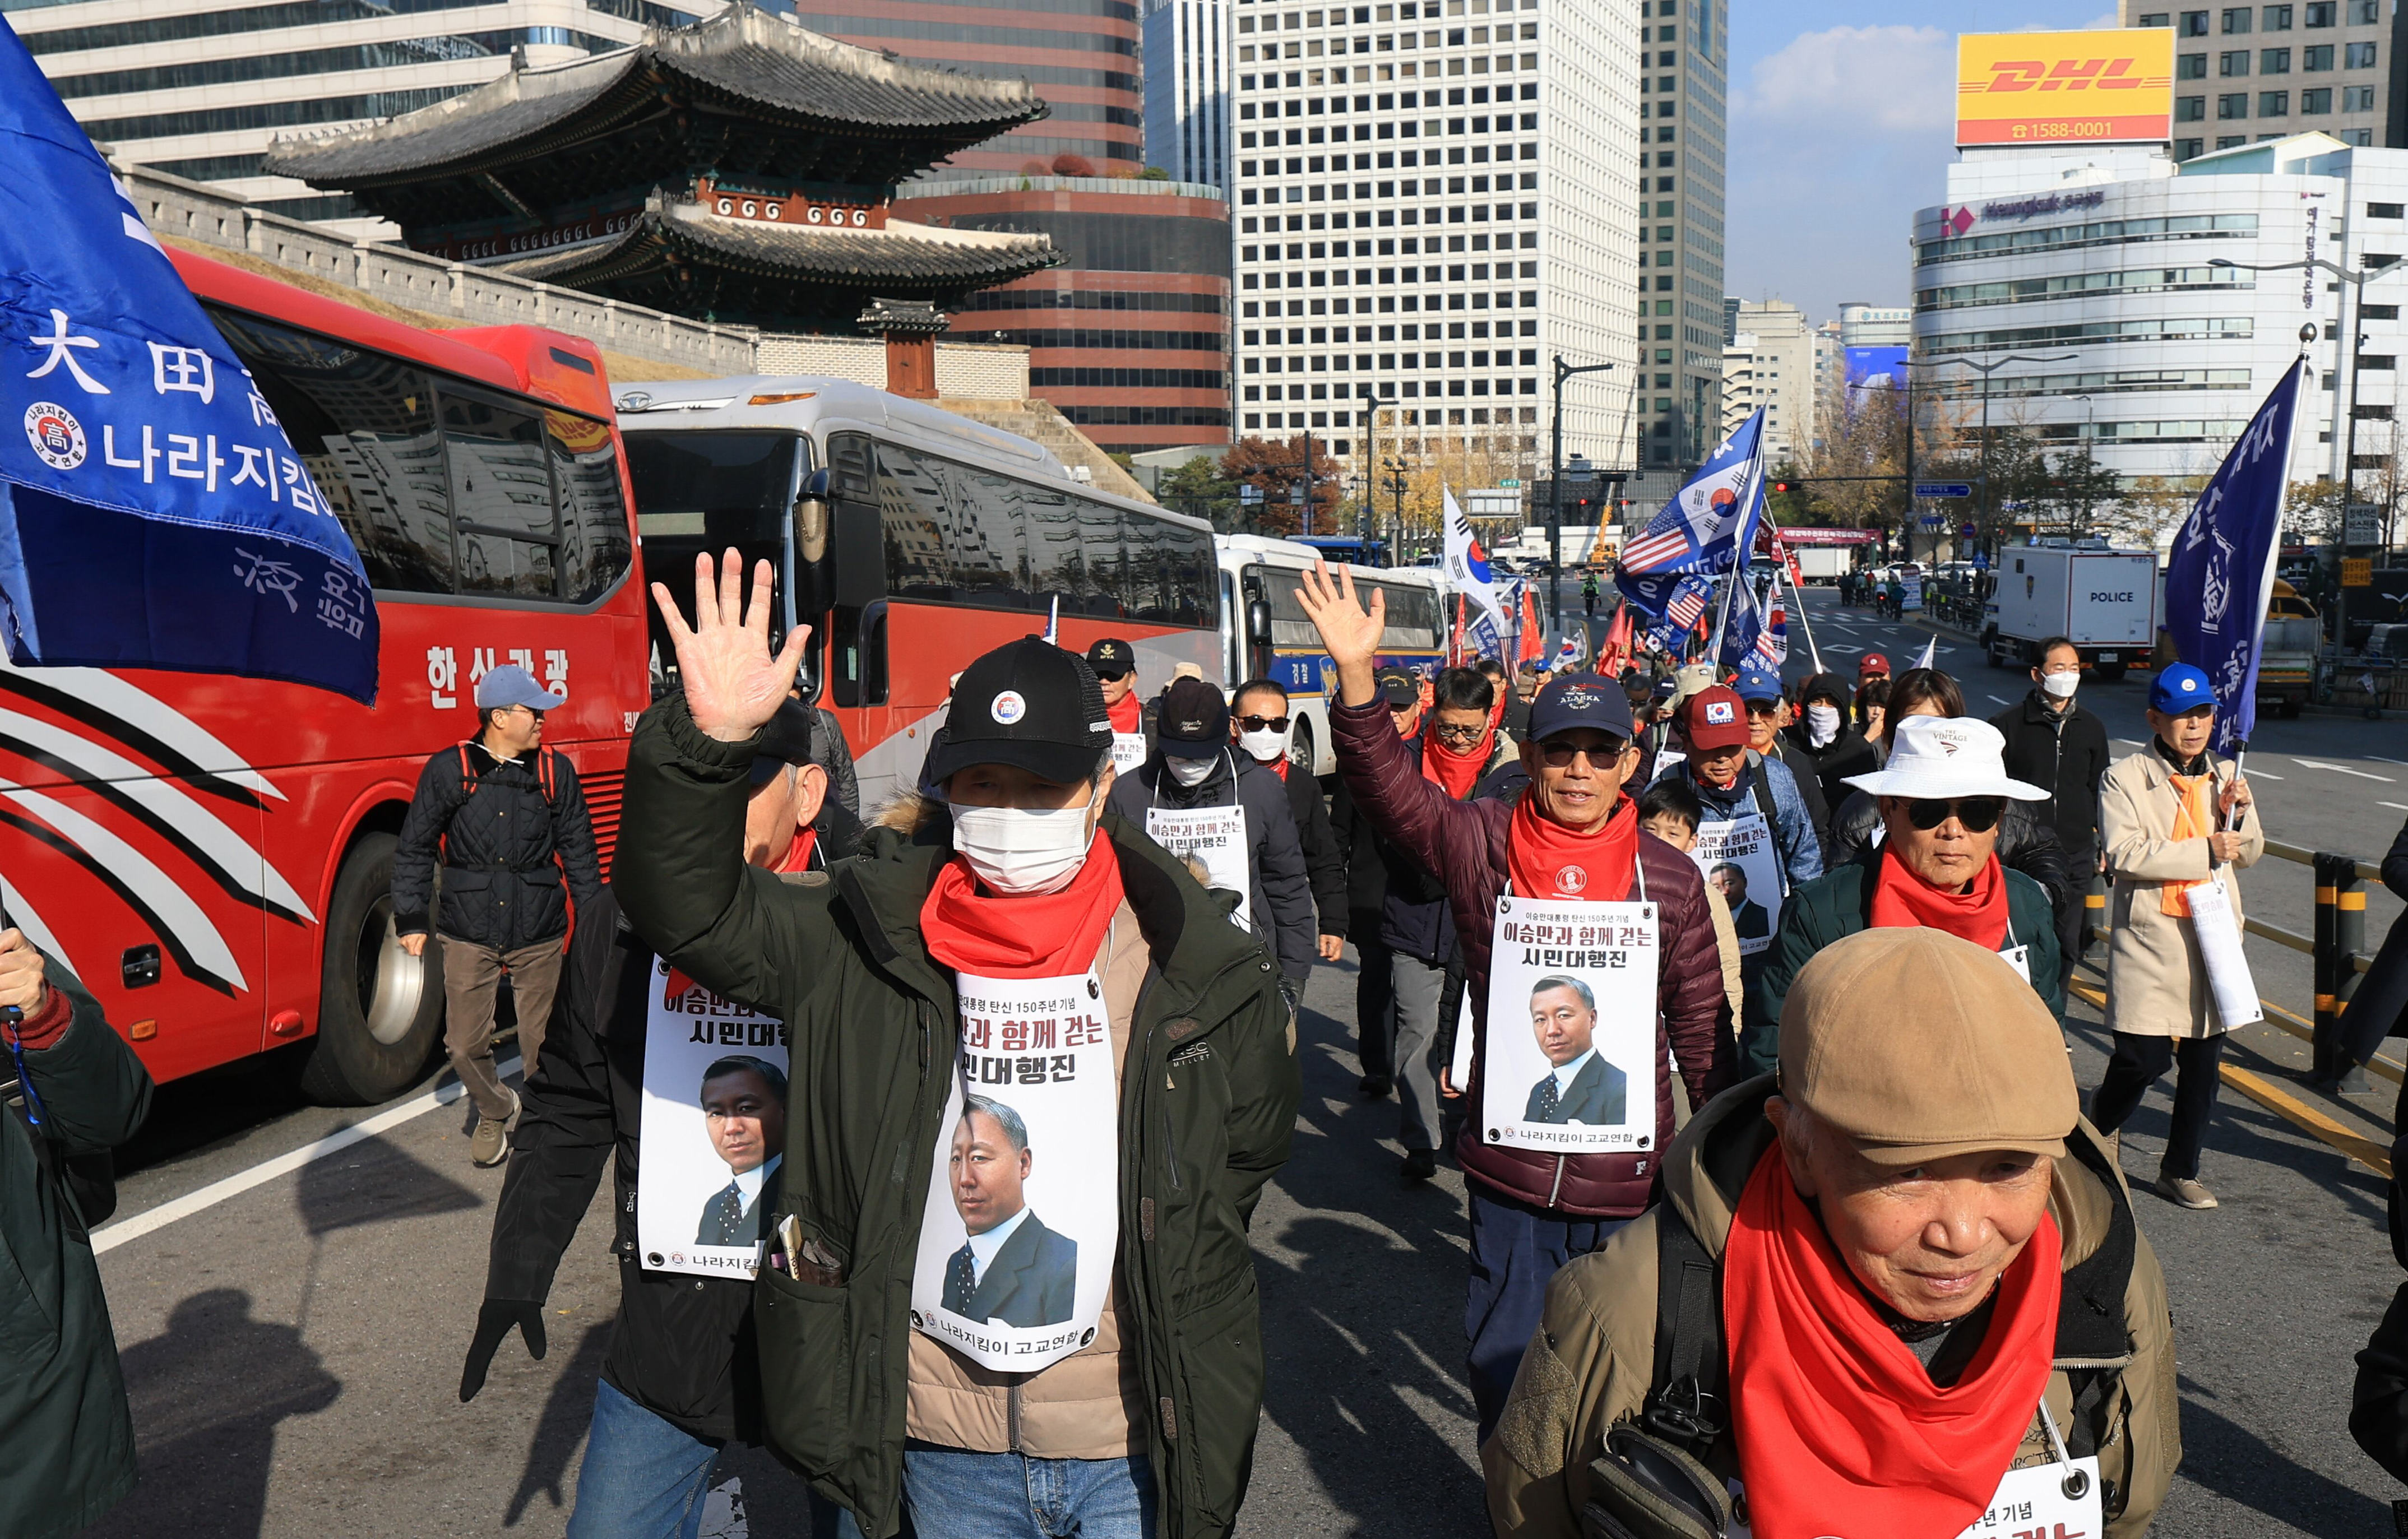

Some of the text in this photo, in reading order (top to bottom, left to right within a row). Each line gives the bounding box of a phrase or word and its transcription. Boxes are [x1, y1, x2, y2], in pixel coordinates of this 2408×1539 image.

[1988, 58, 2146, 92] DHL
[2031, 122, 2113, 139] 1588-0001
[28, 404, 78, 432] 나라지킴이
[43, 422, 68, 451] 高
[34, 442, 84, 467] 고교연합
[2091, 592, 2133, 602] POLICE
[1560, 695, 1600, 703] ALASKA
[1933, 733, 1967, 741] VINTAGE
[1151, 821, 1242, 837] 이승만과 함께 걷는
[1696, 836, 1729, 847] 승만과
[1731, 832, 1750, 845] 함께
[1751, 828, 1768, 841] 걷는
[1702, 842, 1759, 859] 시민대행진
[1526, 912, 1629, 924] 이승만대통령 탄신 150주년 기념
[1503, 921, 1652, 947] 이승만과 함께 걷는
[1521, 948, 1627, 968] 시민대행진
[990, 1000, 1012, 1014] 탄신
[1016, 1000, 1057, 1013] 150주년
[1060, 996, 1075, 1010] 기념
[1002, 1018, 1056, 1050] 함께
[1064, 1014, 1103, 1047] 걷는
[1520, 1129, 1633, 1143] 나라지킴이 고교연합
[940, 1320, 1079, 1356] 나라지킴이 고교연합
[2003, 1501, 2032, 1522] 기념
